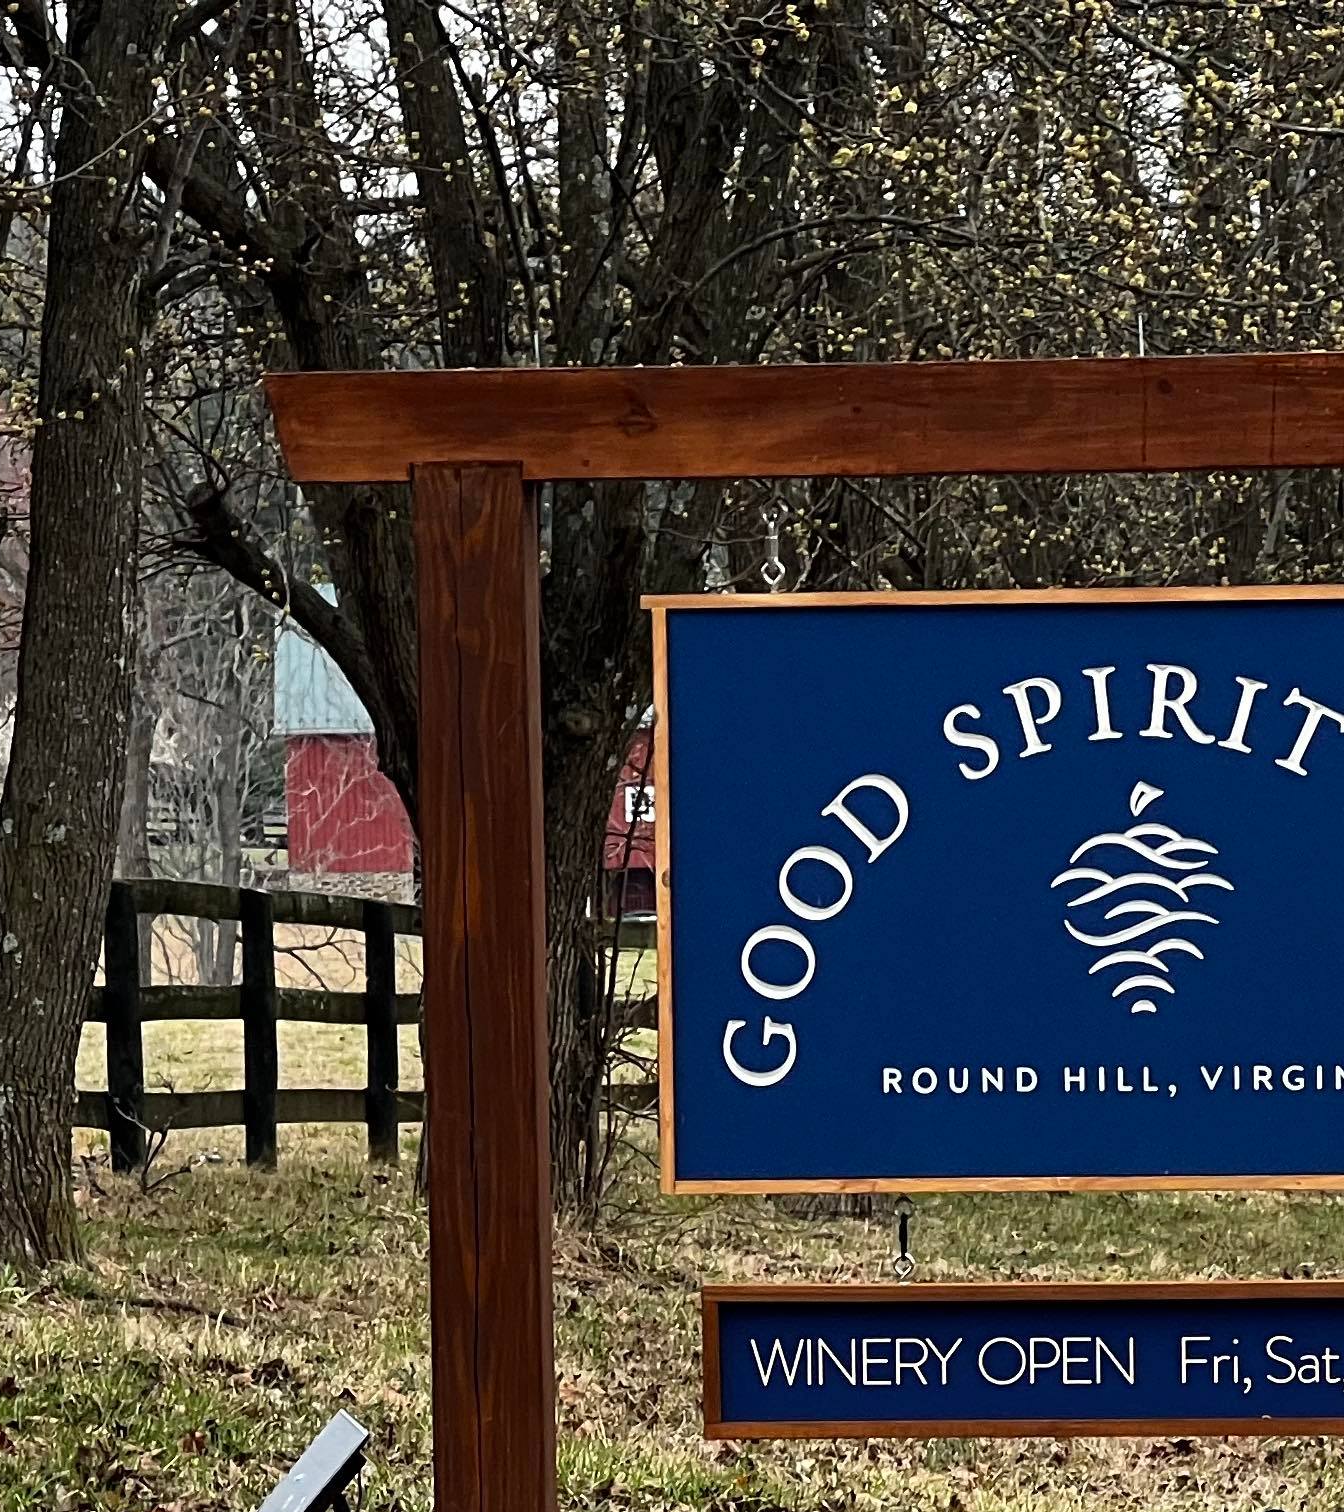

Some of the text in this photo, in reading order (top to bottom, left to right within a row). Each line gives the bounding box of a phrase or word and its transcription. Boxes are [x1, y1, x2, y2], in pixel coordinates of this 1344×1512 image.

[722, 774, 909, 1087] GOOD
[882, 1065, 1039, 1095] ROUND
[1063, 1066, 1178, 1099] HILL,
[750, 1337, 963, 1387] WINERY
[978, 1336, 1135, 1386] OPEN
[1180, 1335, 1253, 1395] Fri,
